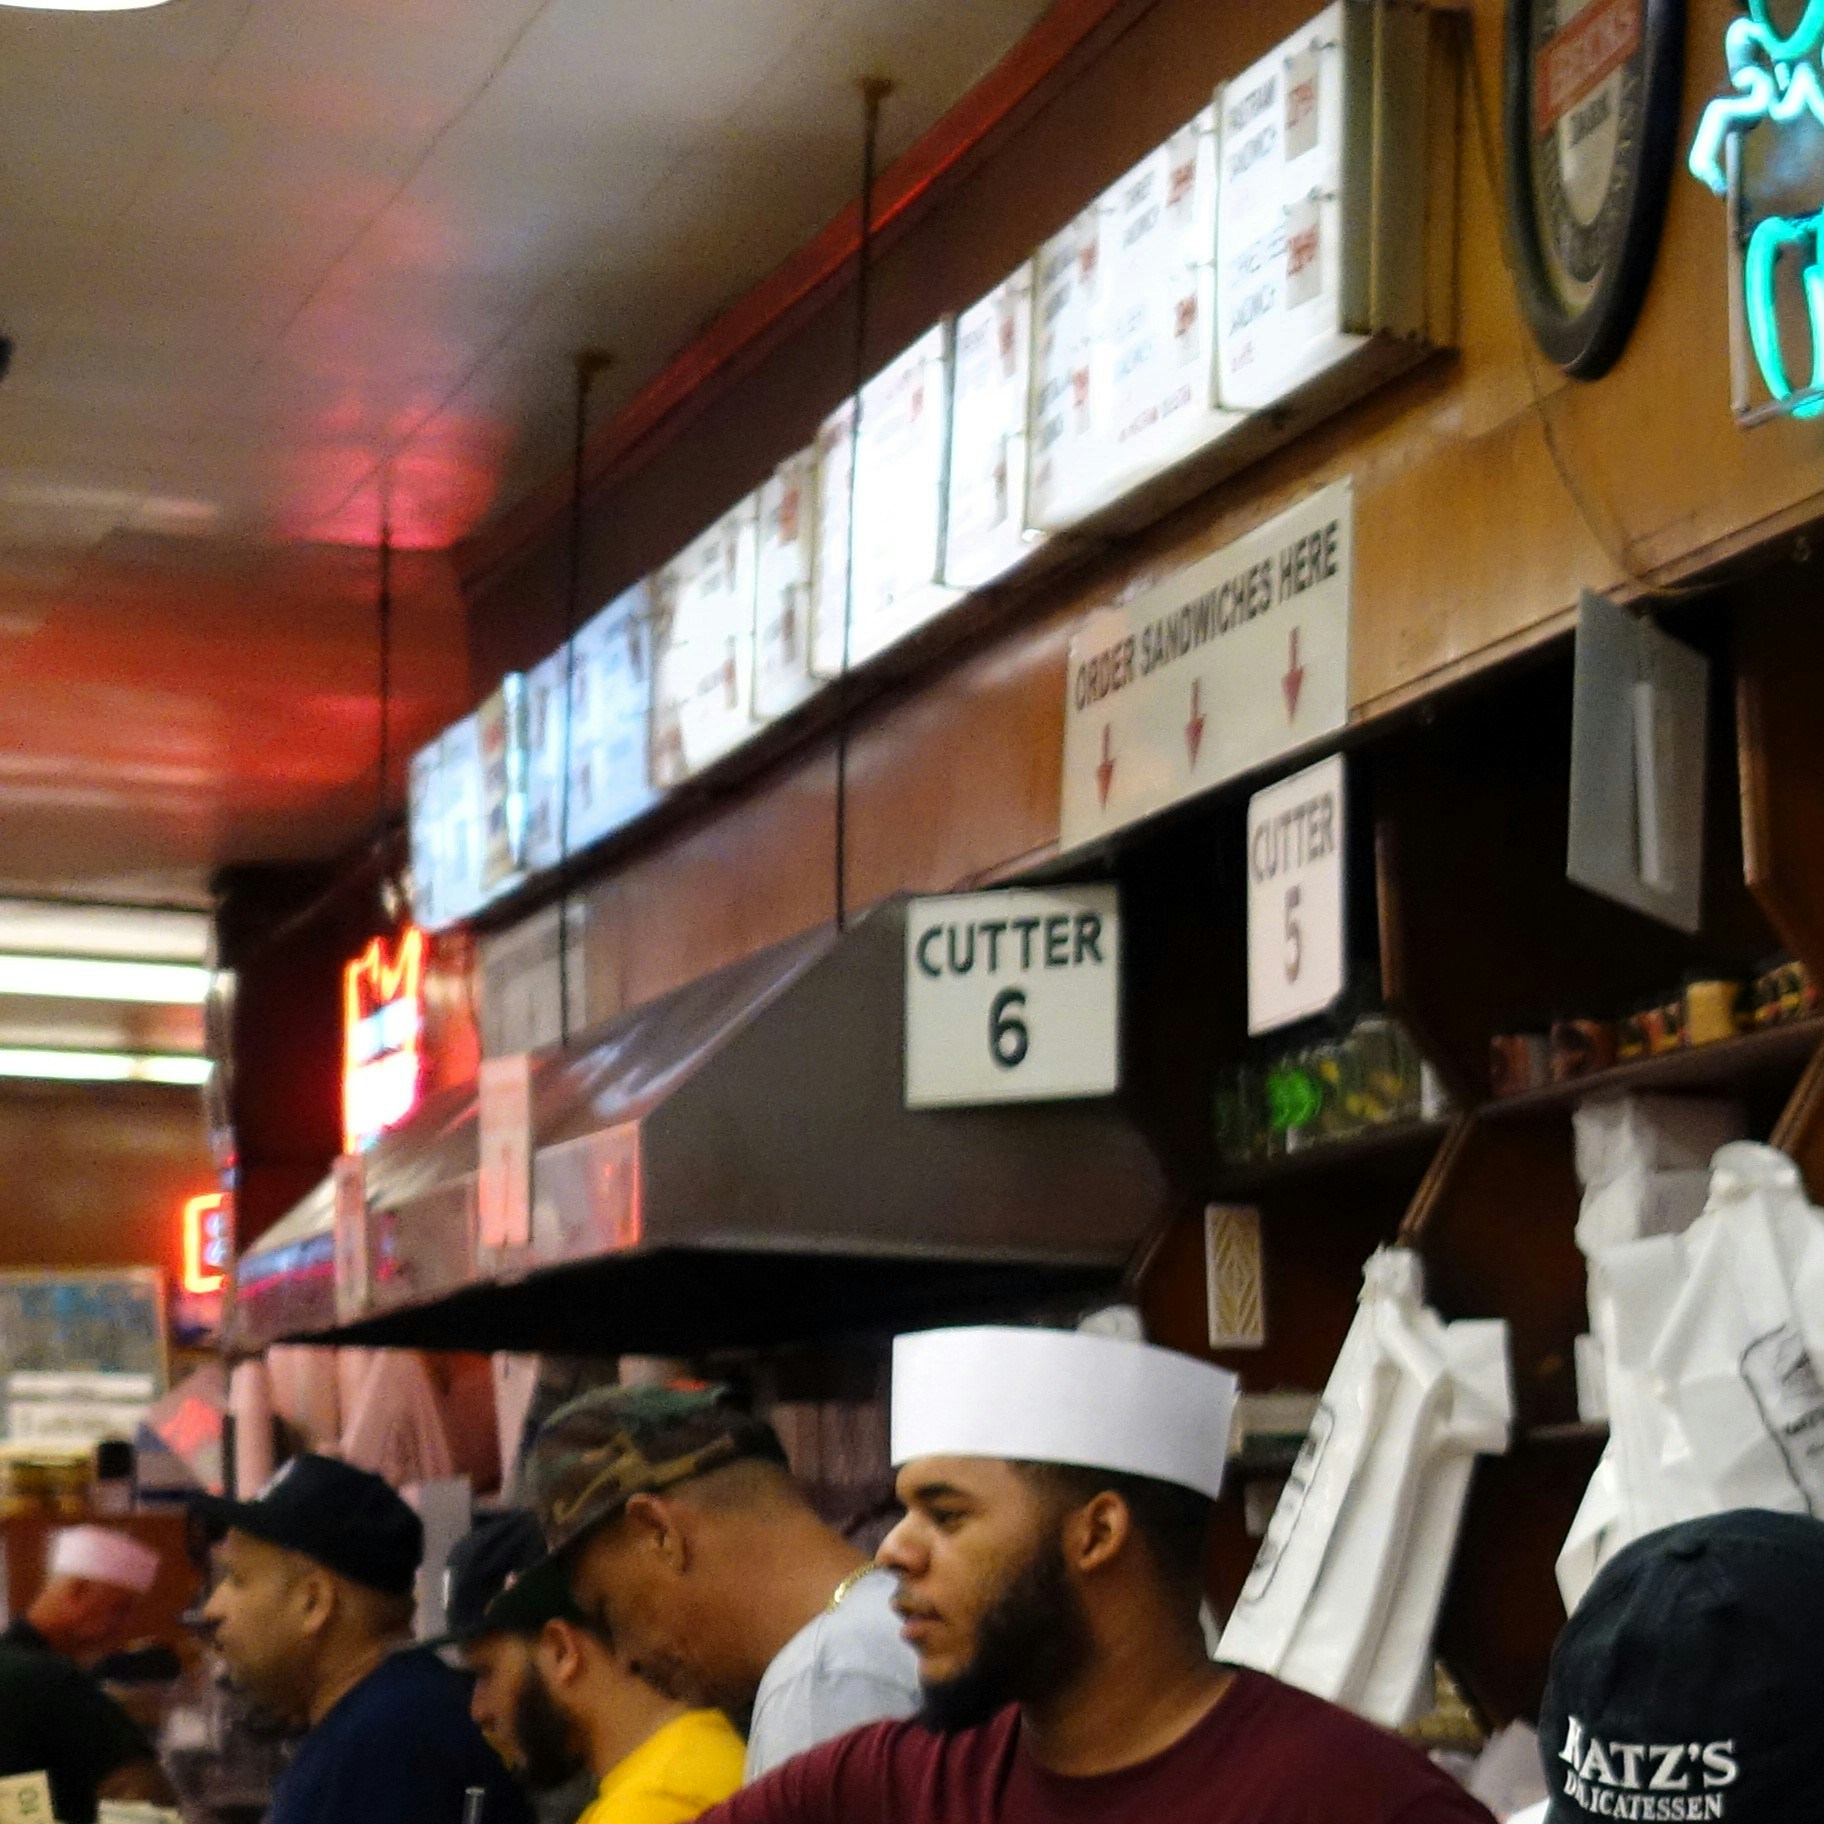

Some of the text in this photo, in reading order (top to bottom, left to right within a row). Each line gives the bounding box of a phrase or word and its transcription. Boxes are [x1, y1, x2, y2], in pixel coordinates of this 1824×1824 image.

[1075, 518, 1339, 712] ORDER SANDWICHES HERE
[1251, 792, 1335, 884] CUTTER
[915, 911, 1105, 979] CUTTER
[1284, 883, 1302, 985] 5
[987, 986, 1029, 1070] 6
[1557, 1713, 1741, 1791] KATZ'S
